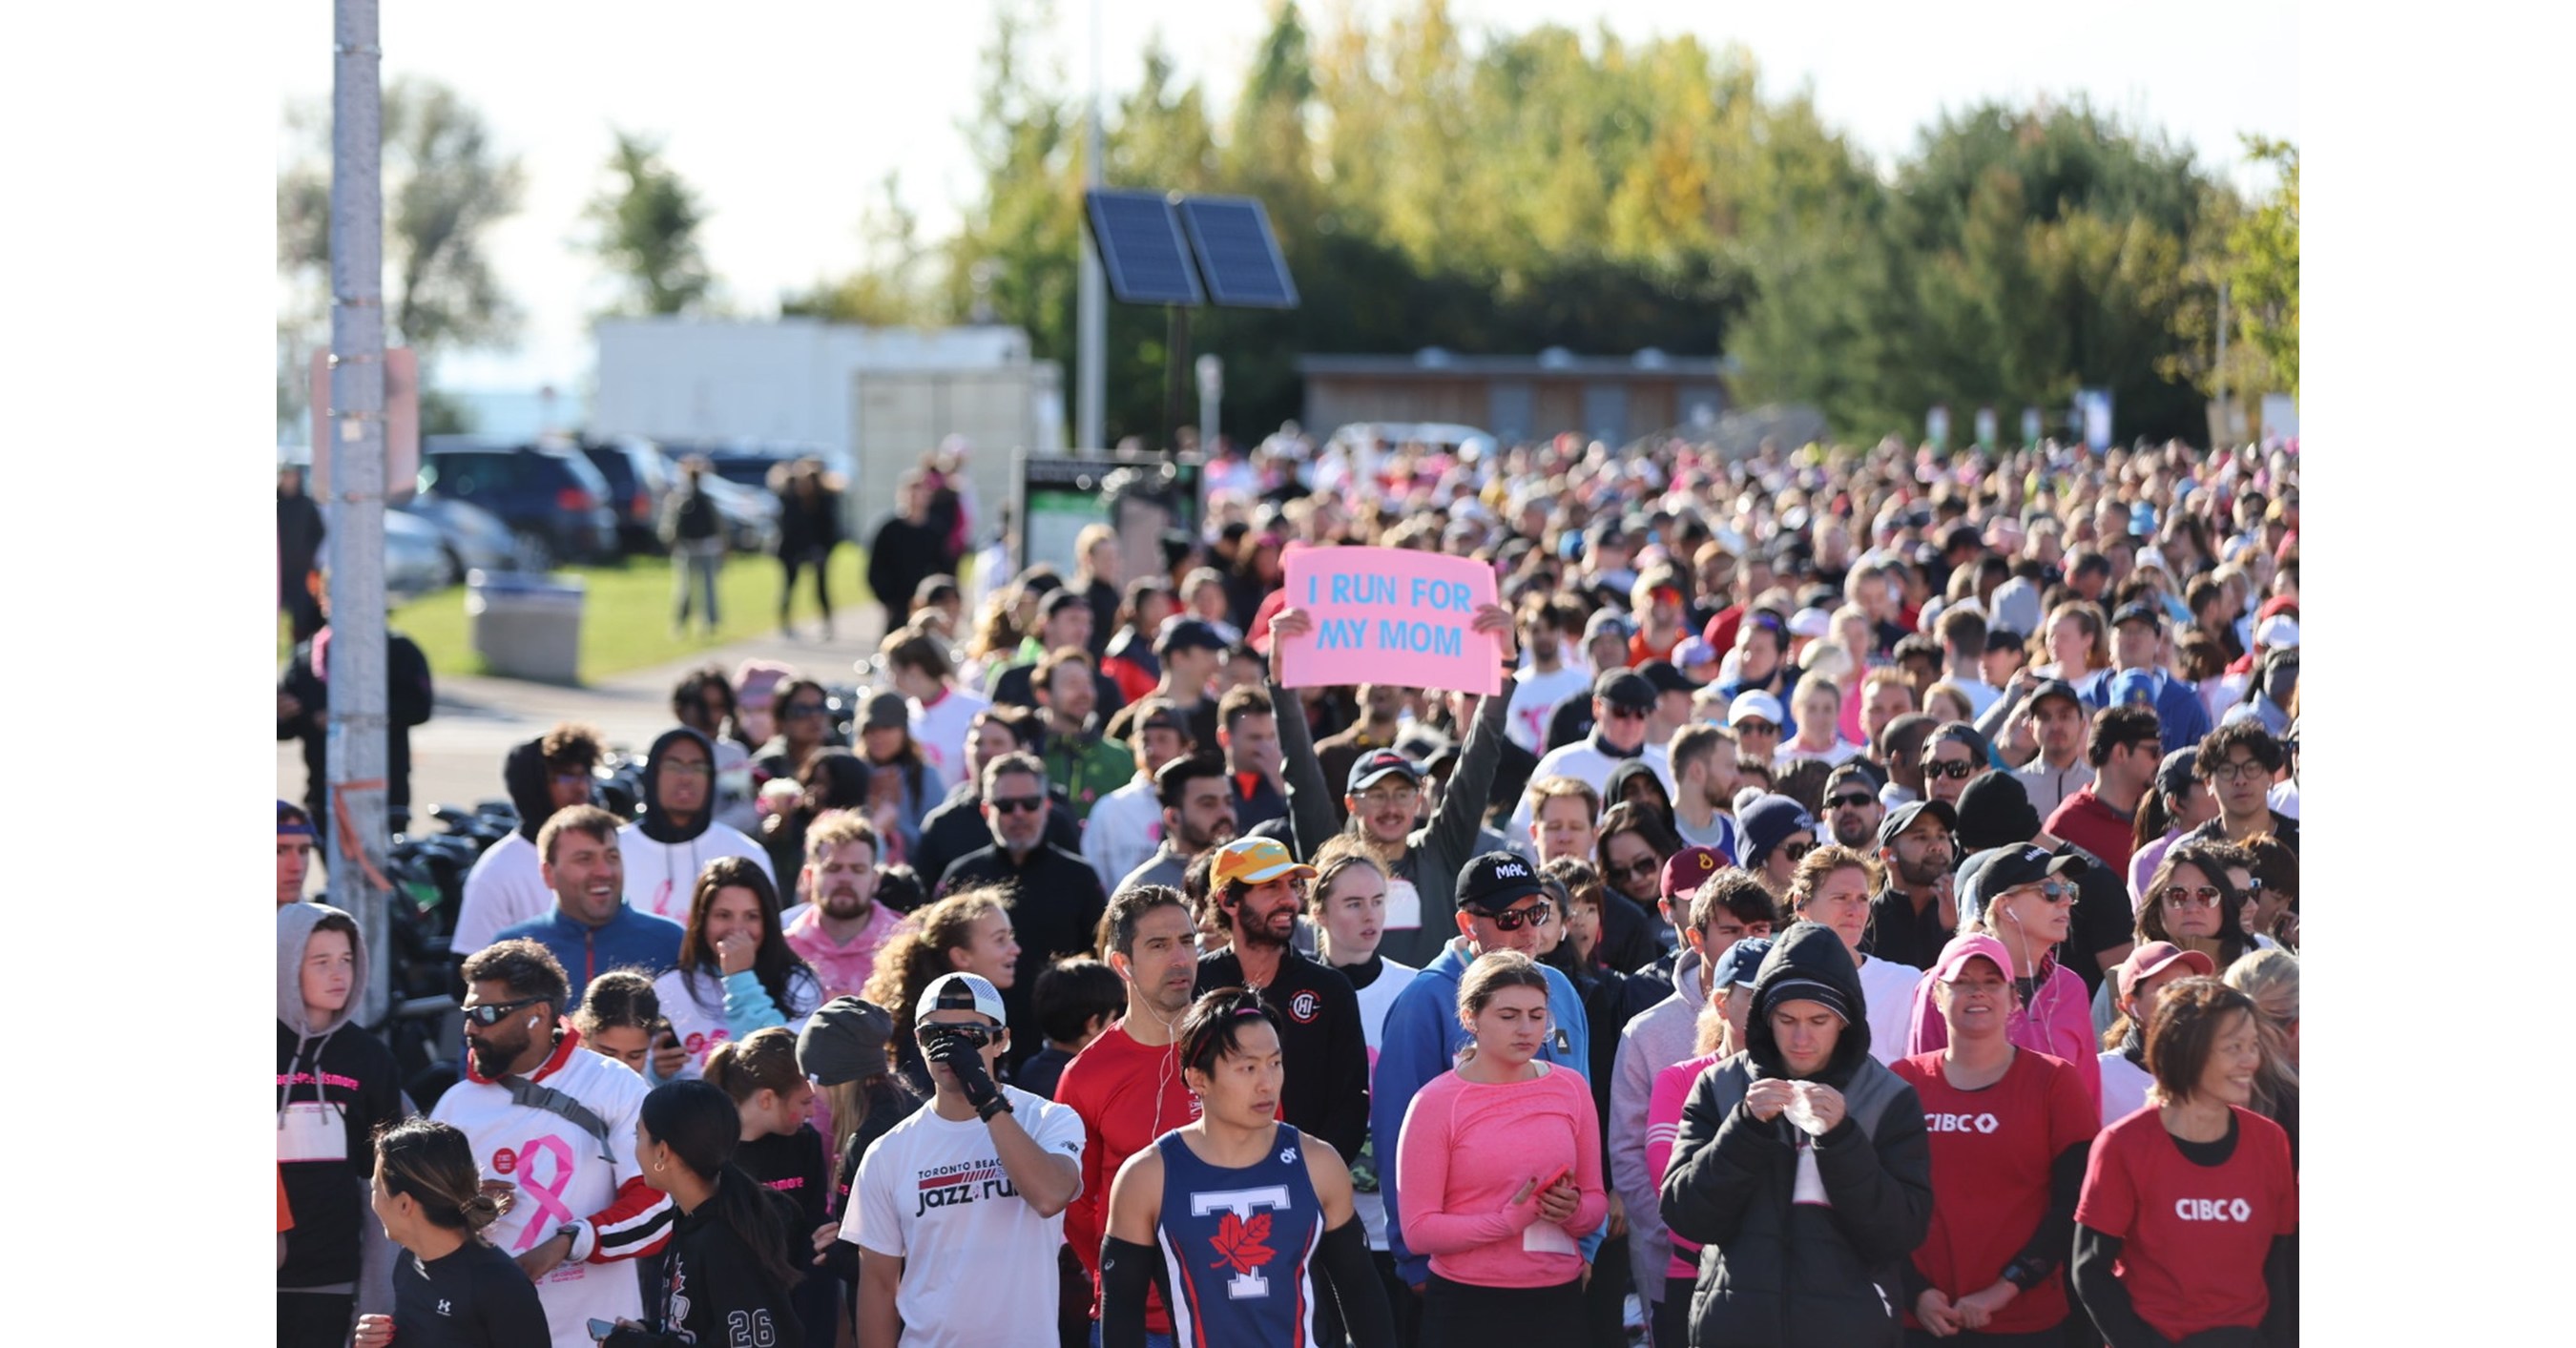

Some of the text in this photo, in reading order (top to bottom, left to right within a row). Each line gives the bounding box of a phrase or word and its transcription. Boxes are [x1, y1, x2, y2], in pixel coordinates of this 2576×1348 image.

[1308, 572, 1472, 613] I RUN FOR
[1316, 618, 1463, 658] MY MOM
[1495, 862, 1528, 880] MAC
[1923, 1112, 1973, 1132] CIBC
[918, 1157, 1003, 1179] TORONTO BEAC
[916, 1184, 973, 1218] jazz
[2175, 1198, 2229, 1221] CIBC
[1190, 1184, 1291, 1300] T
[727, 1308, 776, 1348] 26
